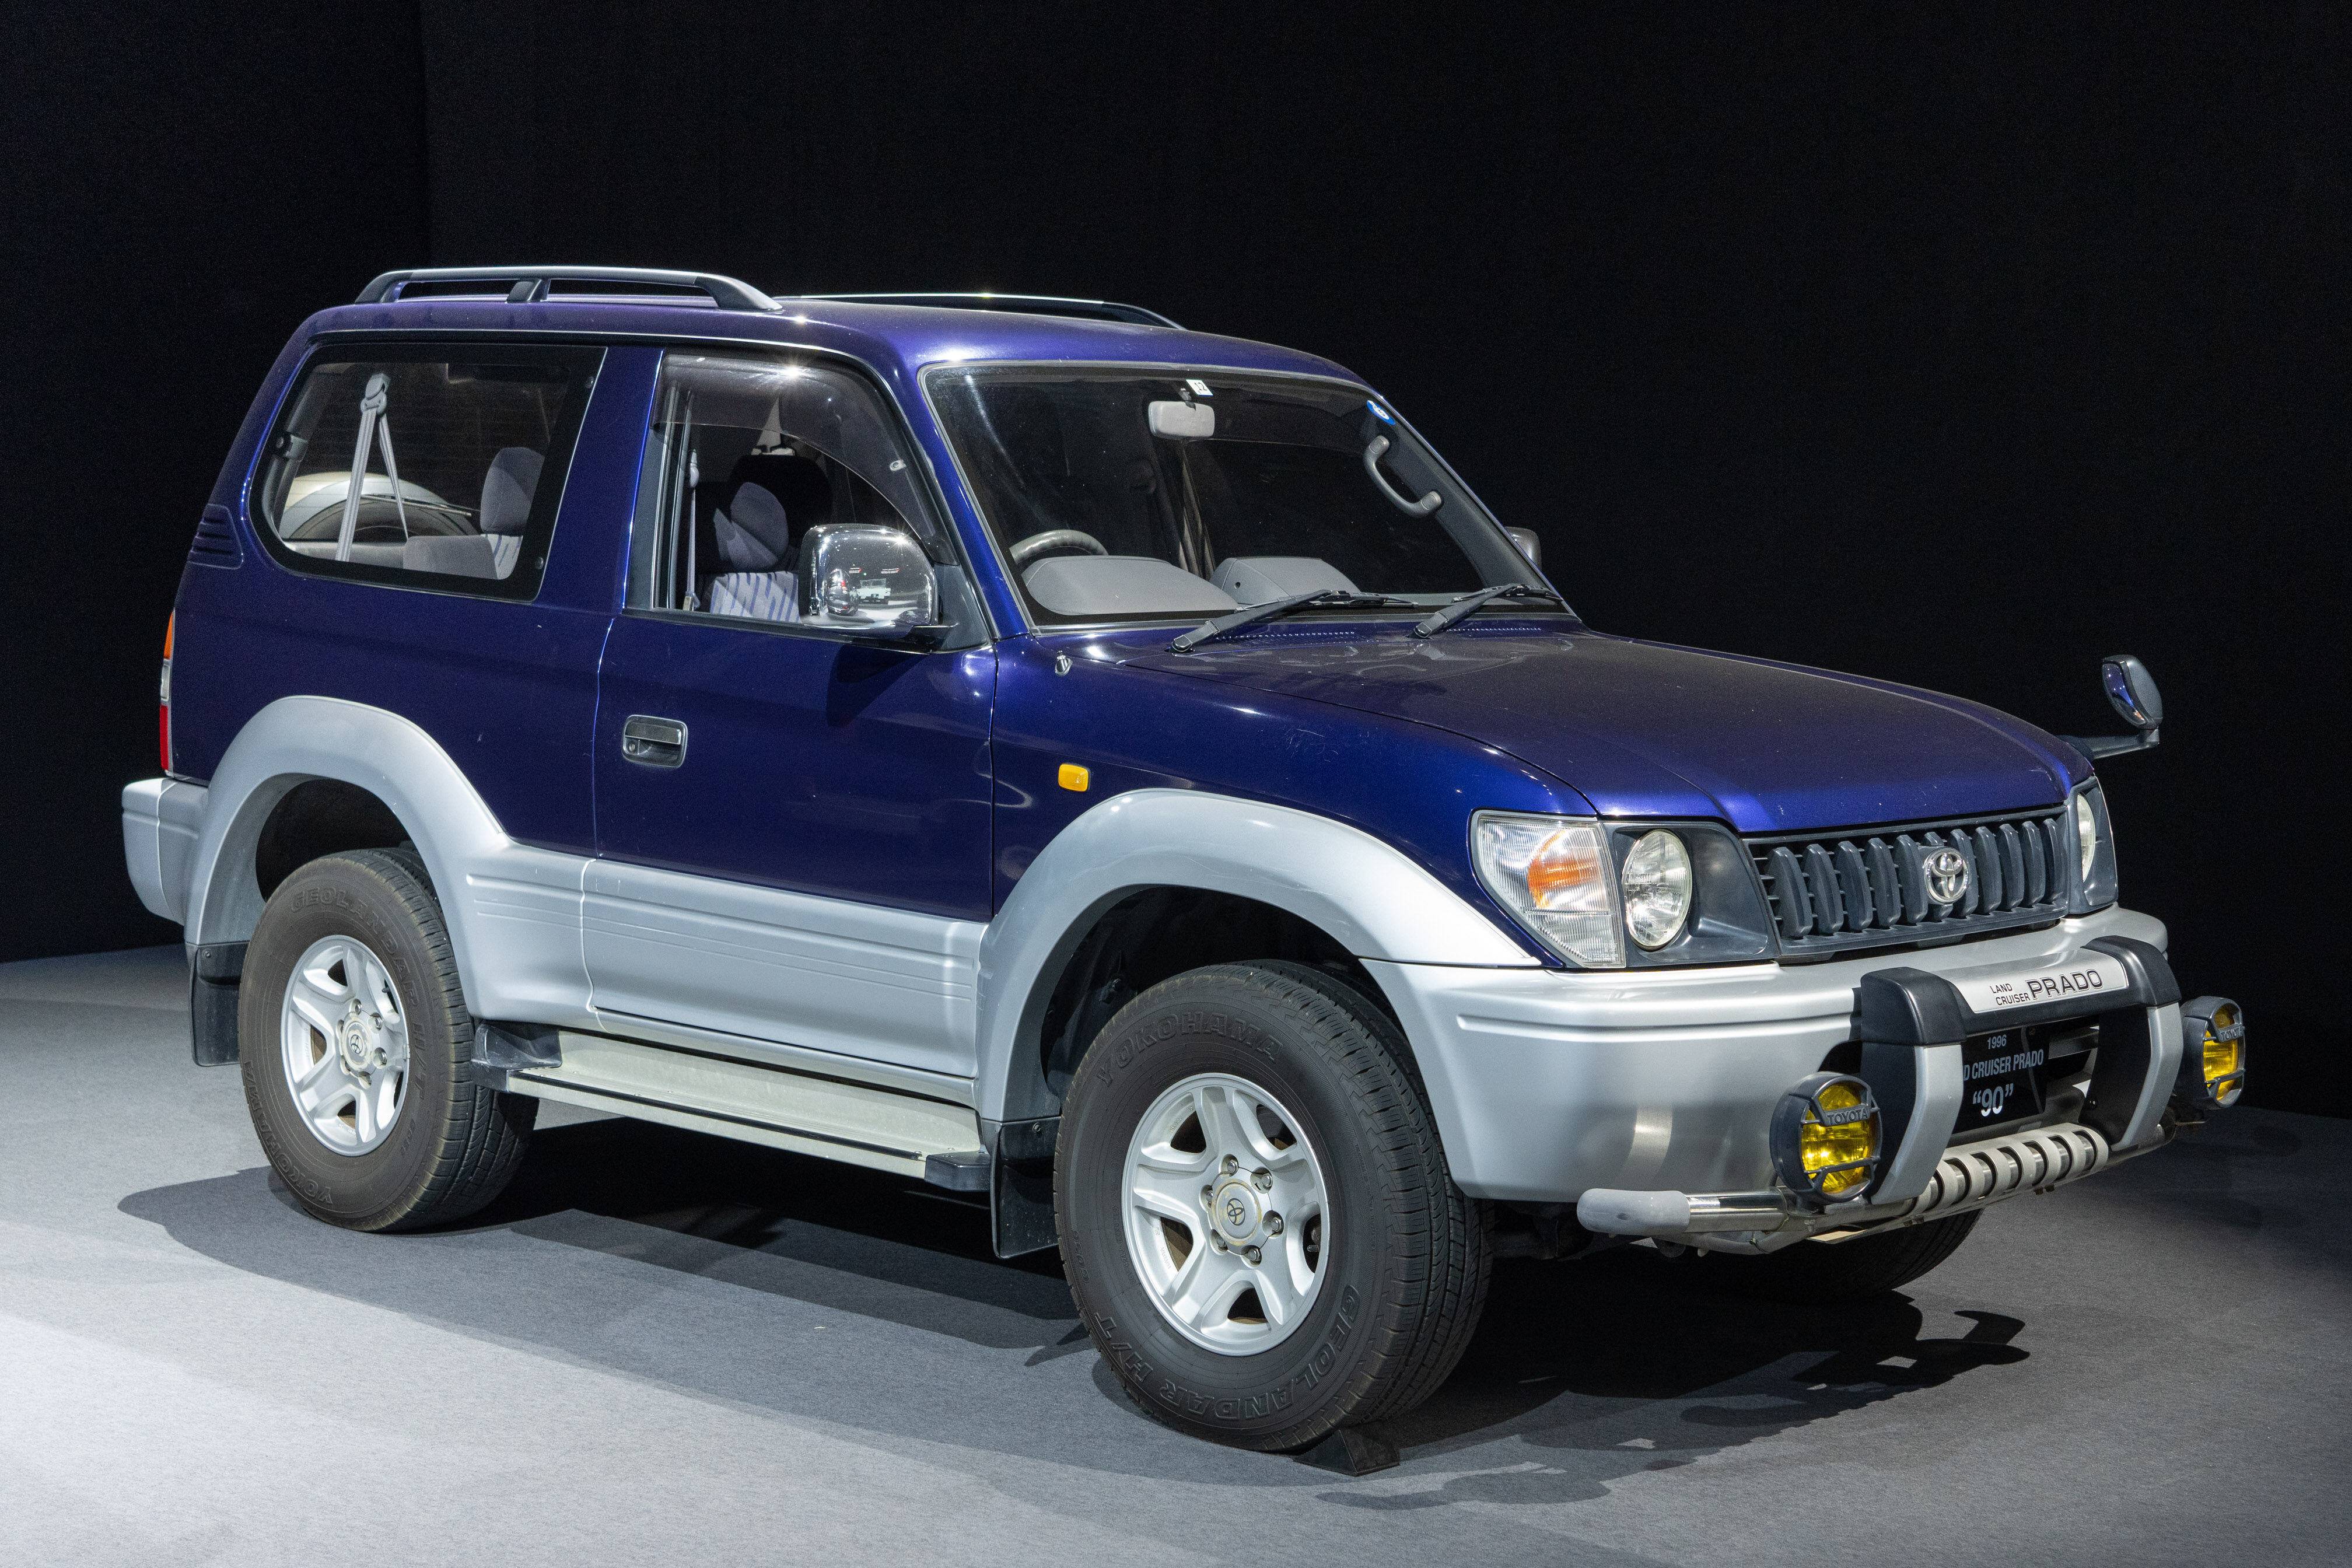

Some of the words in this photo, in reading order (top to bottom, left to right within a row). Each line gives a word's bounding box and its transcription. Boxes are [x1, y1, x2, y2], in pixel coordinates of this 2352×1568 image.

[1194, 382, 1208, 391] 12
[1989, 983, 2013, 994] LAND
[2024, 968, 2104, 1000] PRADO
[1996, 992, 2031, 1006] CRUISER
[1987, 1034, 2007, 1049] 1996
[2220, 1026, 2244, 1041] TOYOTA
[1096, 1011, 1283, 1087] YOKOHAMA
[1971, 1056, 2011, 1080] CRUISER
[2013, 1049, 2044, 1071] PRADO
[1826, 1107, 1868, 1125] TOYOTA
[1094, 1312, 1153, 1382] H/T
[1160, 1284, 1362, 1420] GEOLANDAR
